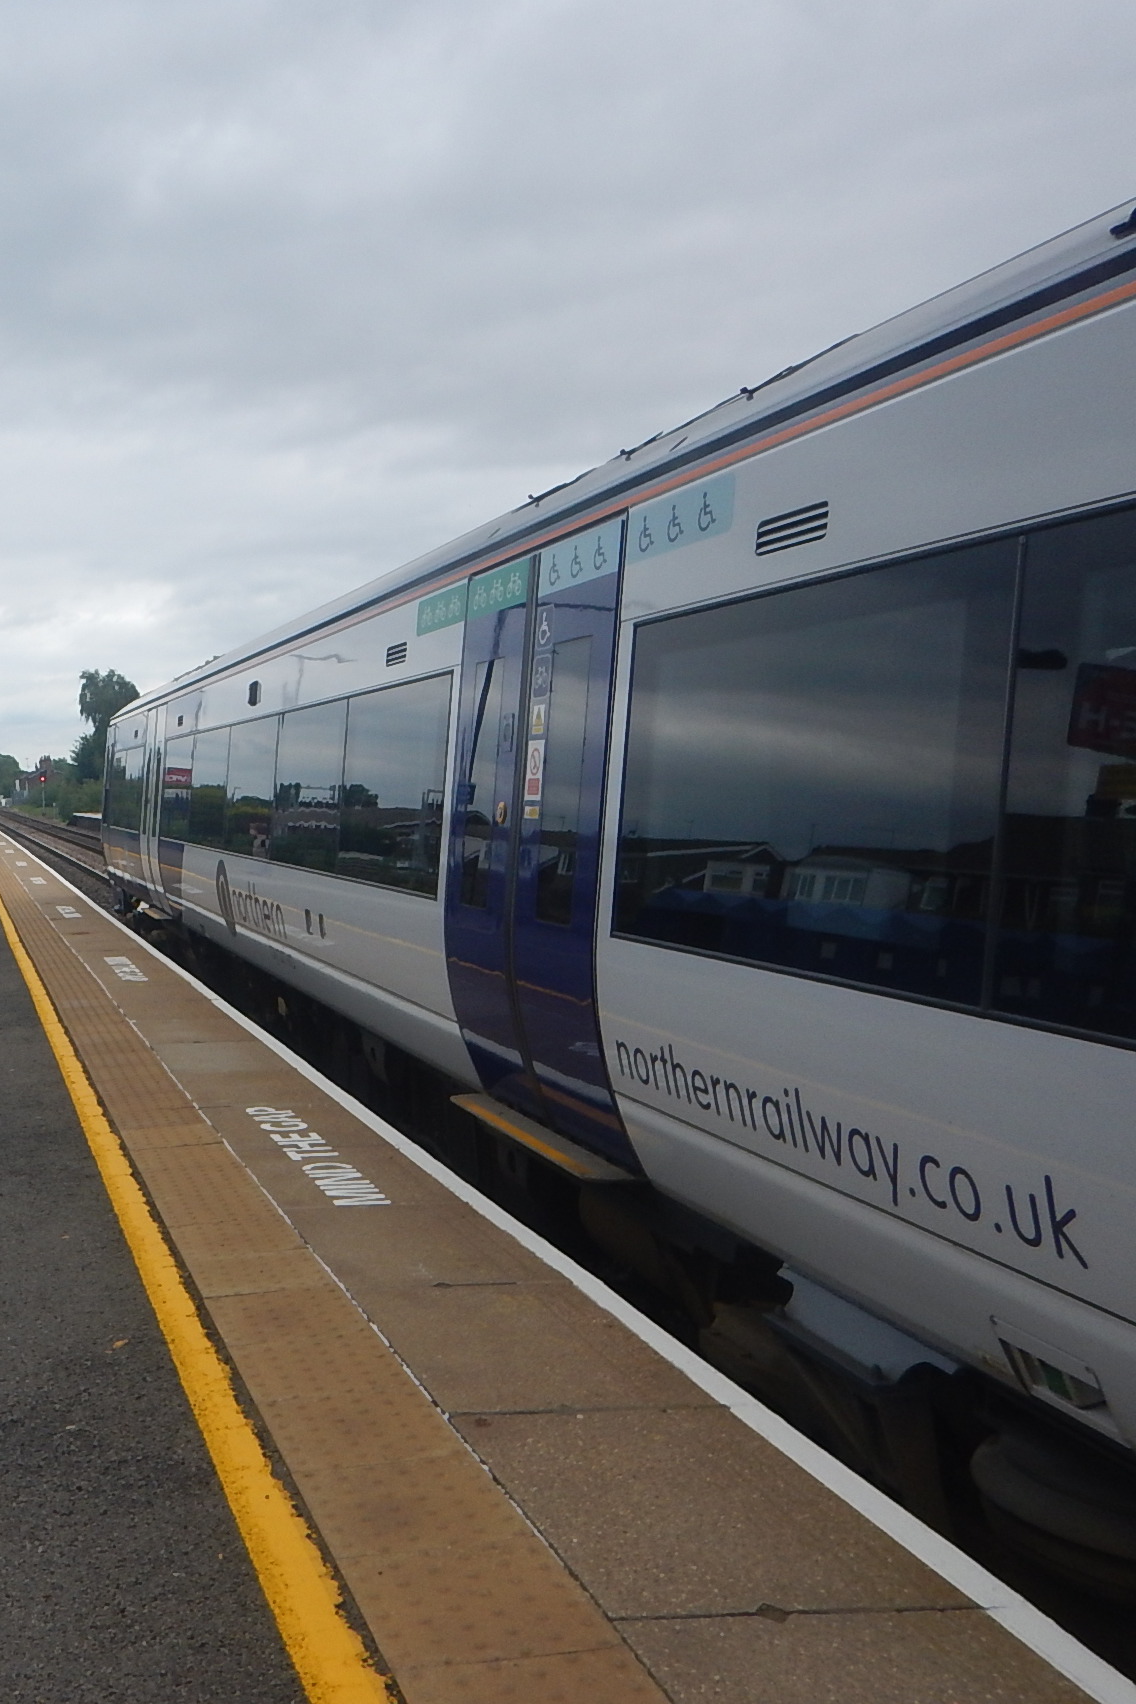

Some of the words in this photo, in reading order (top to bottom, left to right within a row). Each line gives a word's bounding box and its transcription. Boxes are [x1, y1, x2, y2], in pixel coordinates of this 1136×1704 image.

[231, 880, 288, 940] northern
[245, 1106, 309, 1131] GAP
[269, 1132, 340, 1161] THE
[615, 1039, 1089, 1270] northernrailway.co.uk
[301, 1162, 392, 1206] MIND
